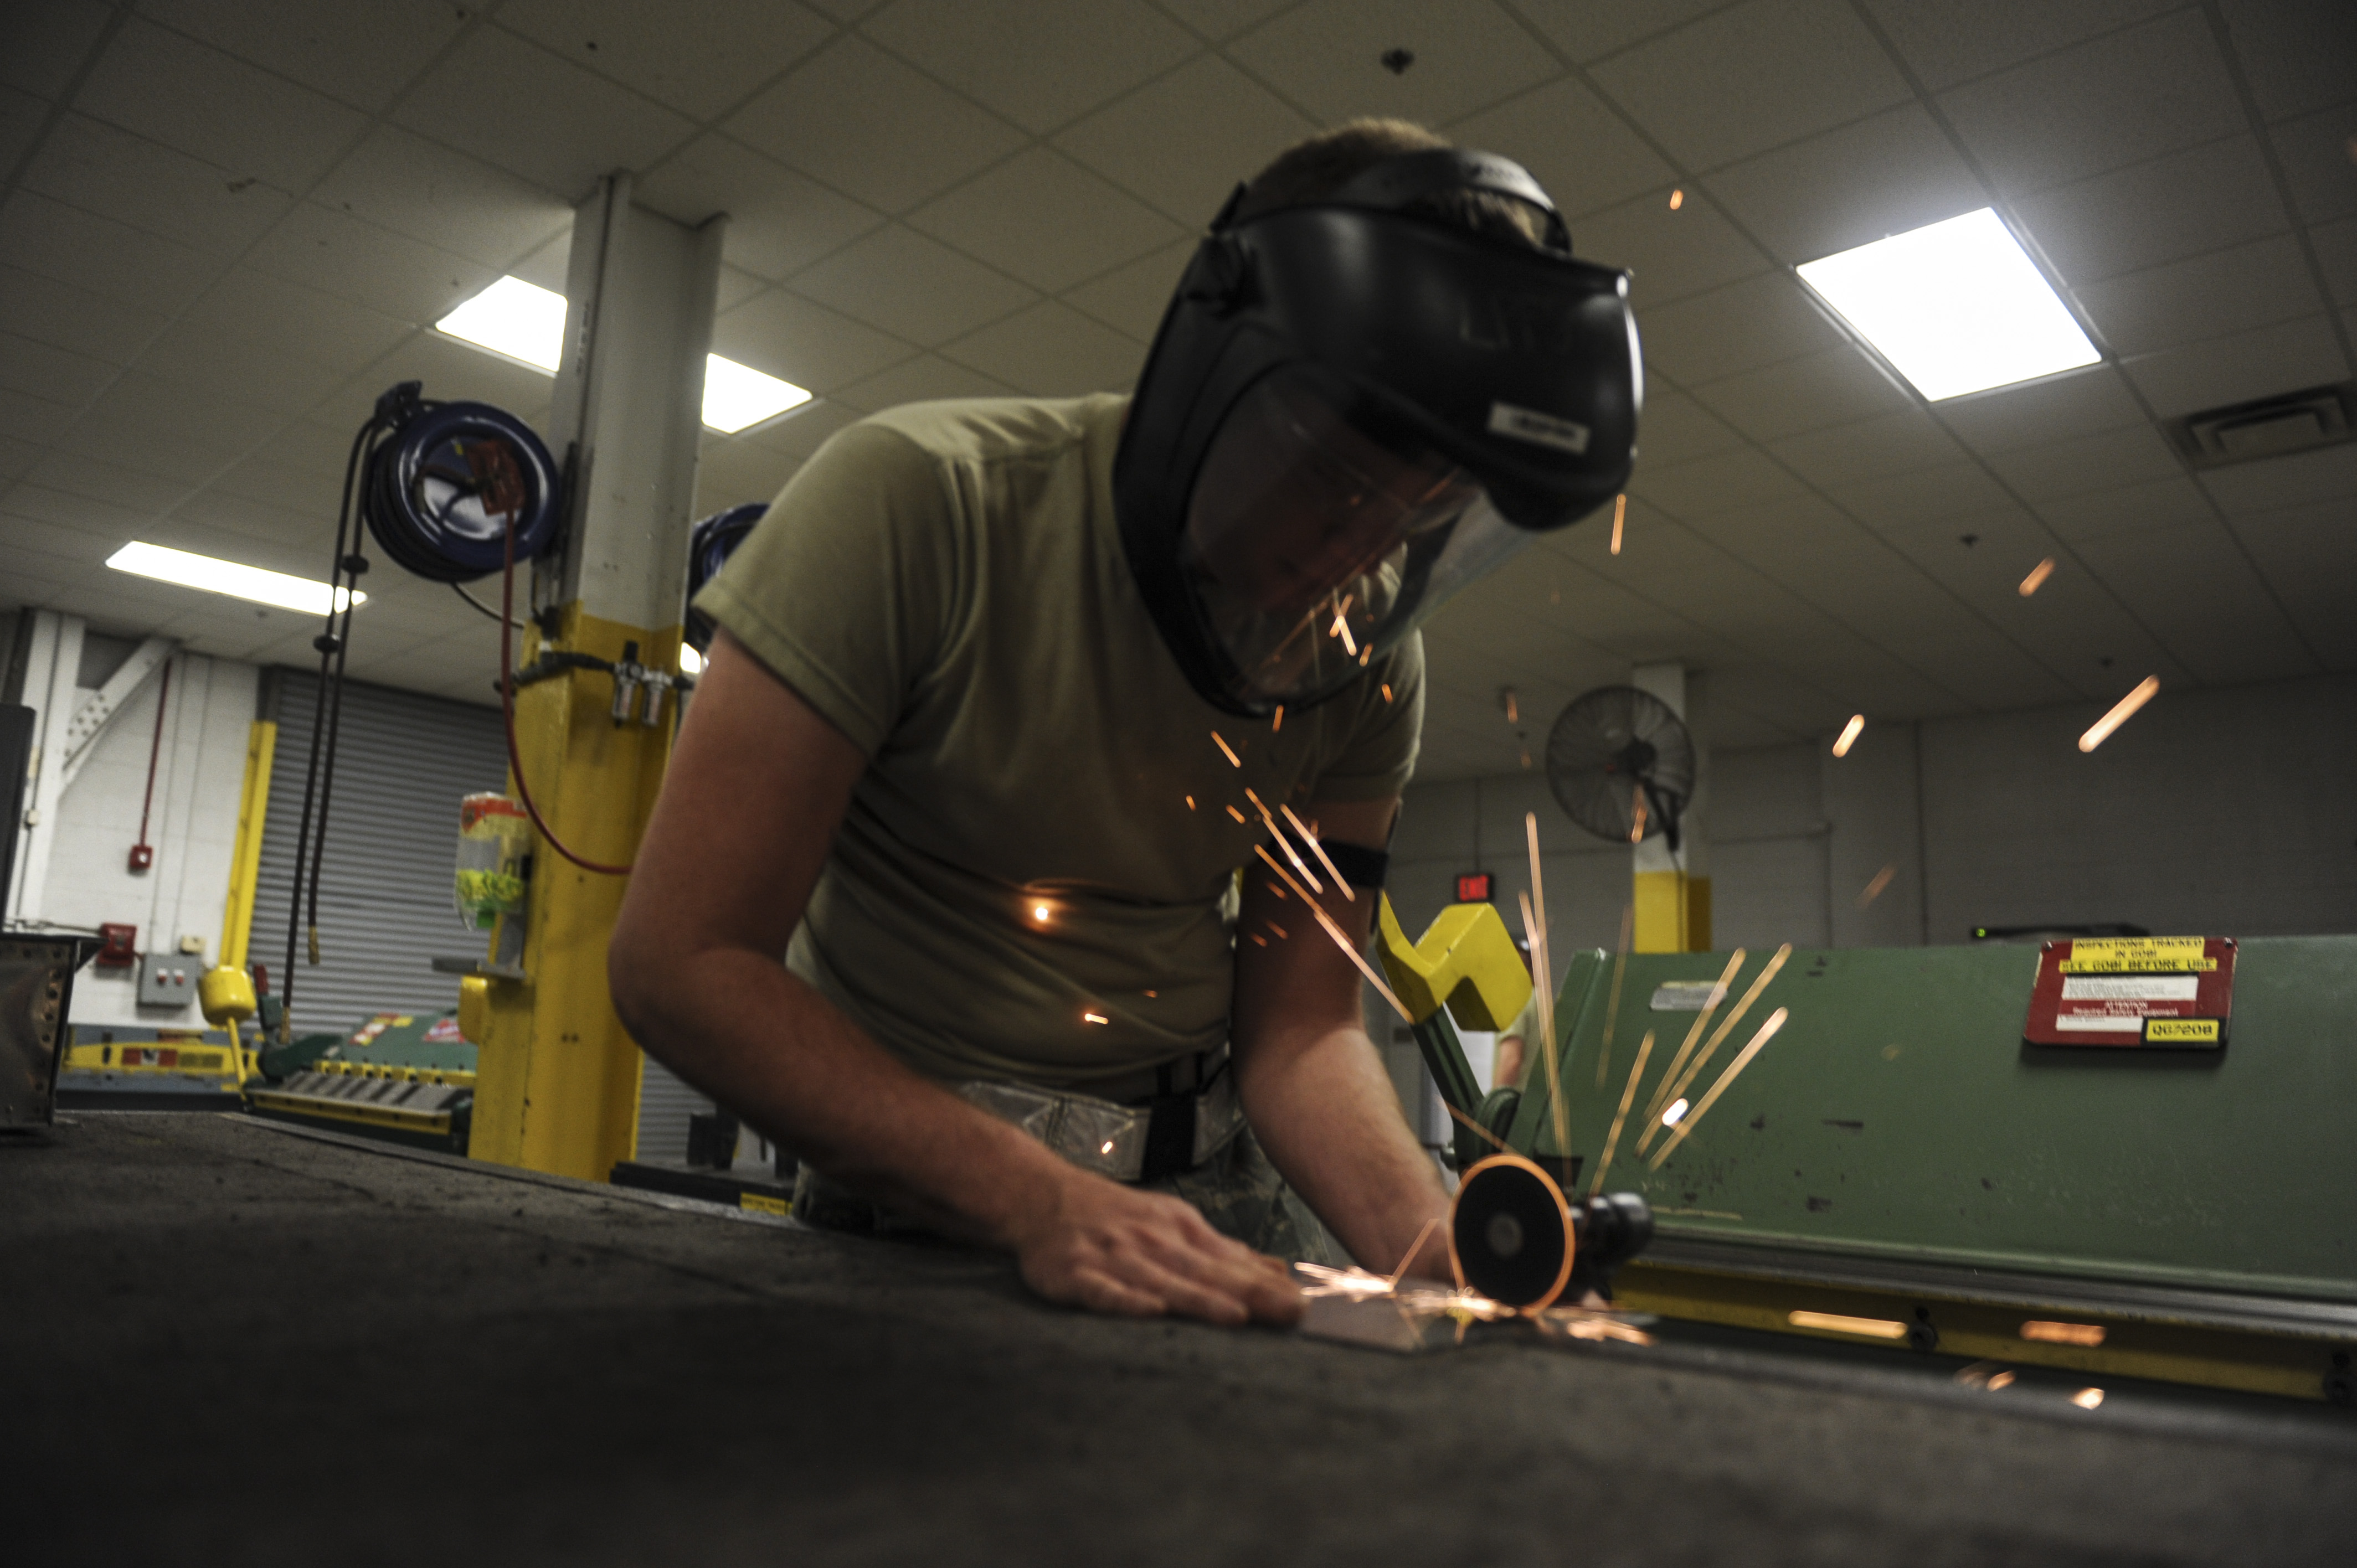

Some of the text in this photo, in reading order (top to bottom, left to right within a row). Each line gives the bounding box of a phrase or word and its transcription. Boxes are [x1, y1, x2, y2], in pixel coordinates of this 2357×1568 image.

[2152, 938, 2202, 947] TRACKED
[2116, 950, 2125, 958] IN
[2062, 961, 2086, 972] SEE
[2128, 959, 2179, 971] BEFORE
[2187, 958, 2216, 970] USE
